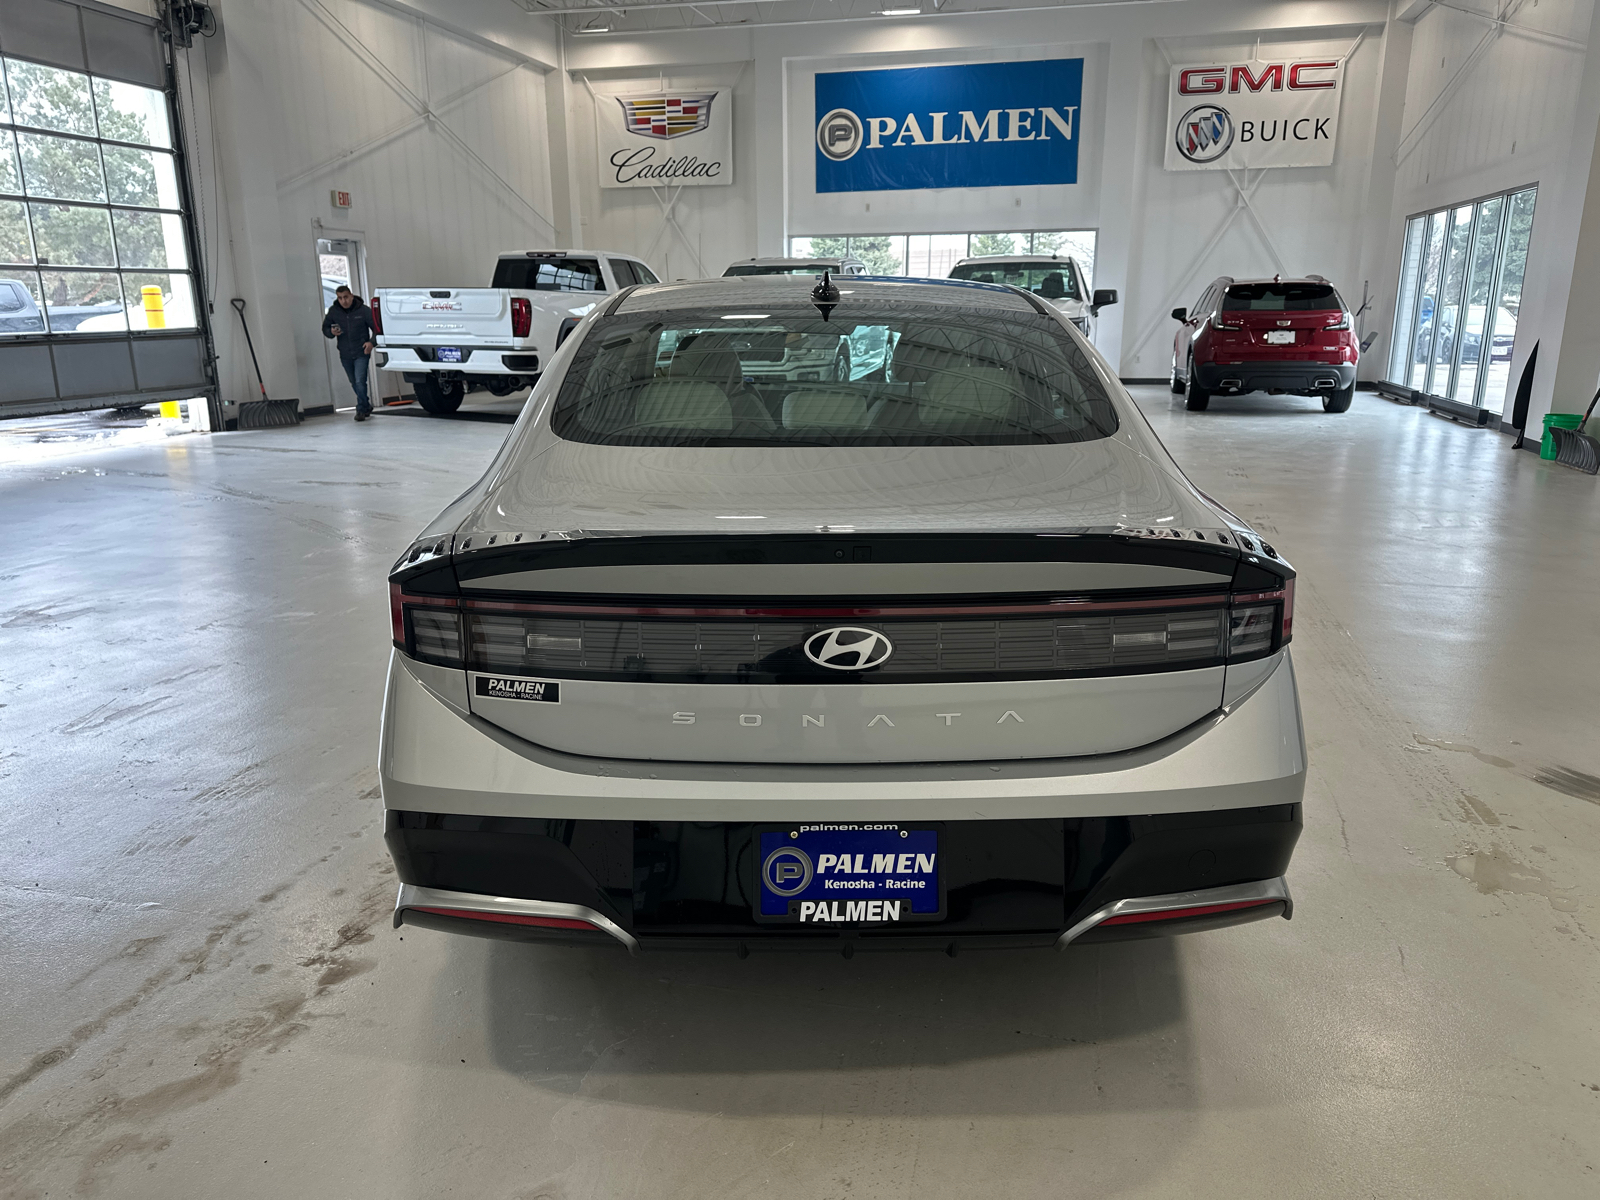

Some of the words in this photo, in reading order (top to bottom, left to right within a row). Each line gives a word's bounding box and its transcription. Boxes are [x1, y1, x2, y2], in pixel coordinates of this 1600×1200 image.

[1177, 61, 1339, 96] GMC
[865, 106, 1079, 149] PALMEN
[1240, 117, 1331, 143] BUICK
[609, 146, 721, 184] Cadillac
[337, 191, 350, 206] EXIT
[488, 679, 545, 694] PALMEN
[489, 690, 517, 698] KENOSHA
[520, 692, 542, 700] RACINE
[672, 710, 1025, 728] SONATA
[800, 823, 898, 833] palmen.com
[816, 853, 935, 874] PALMEN
[824, 879, 875, 889] Kenosha
[885, 879, 926, 889] Racine
[800, 900, 900, 922] PALMEN
